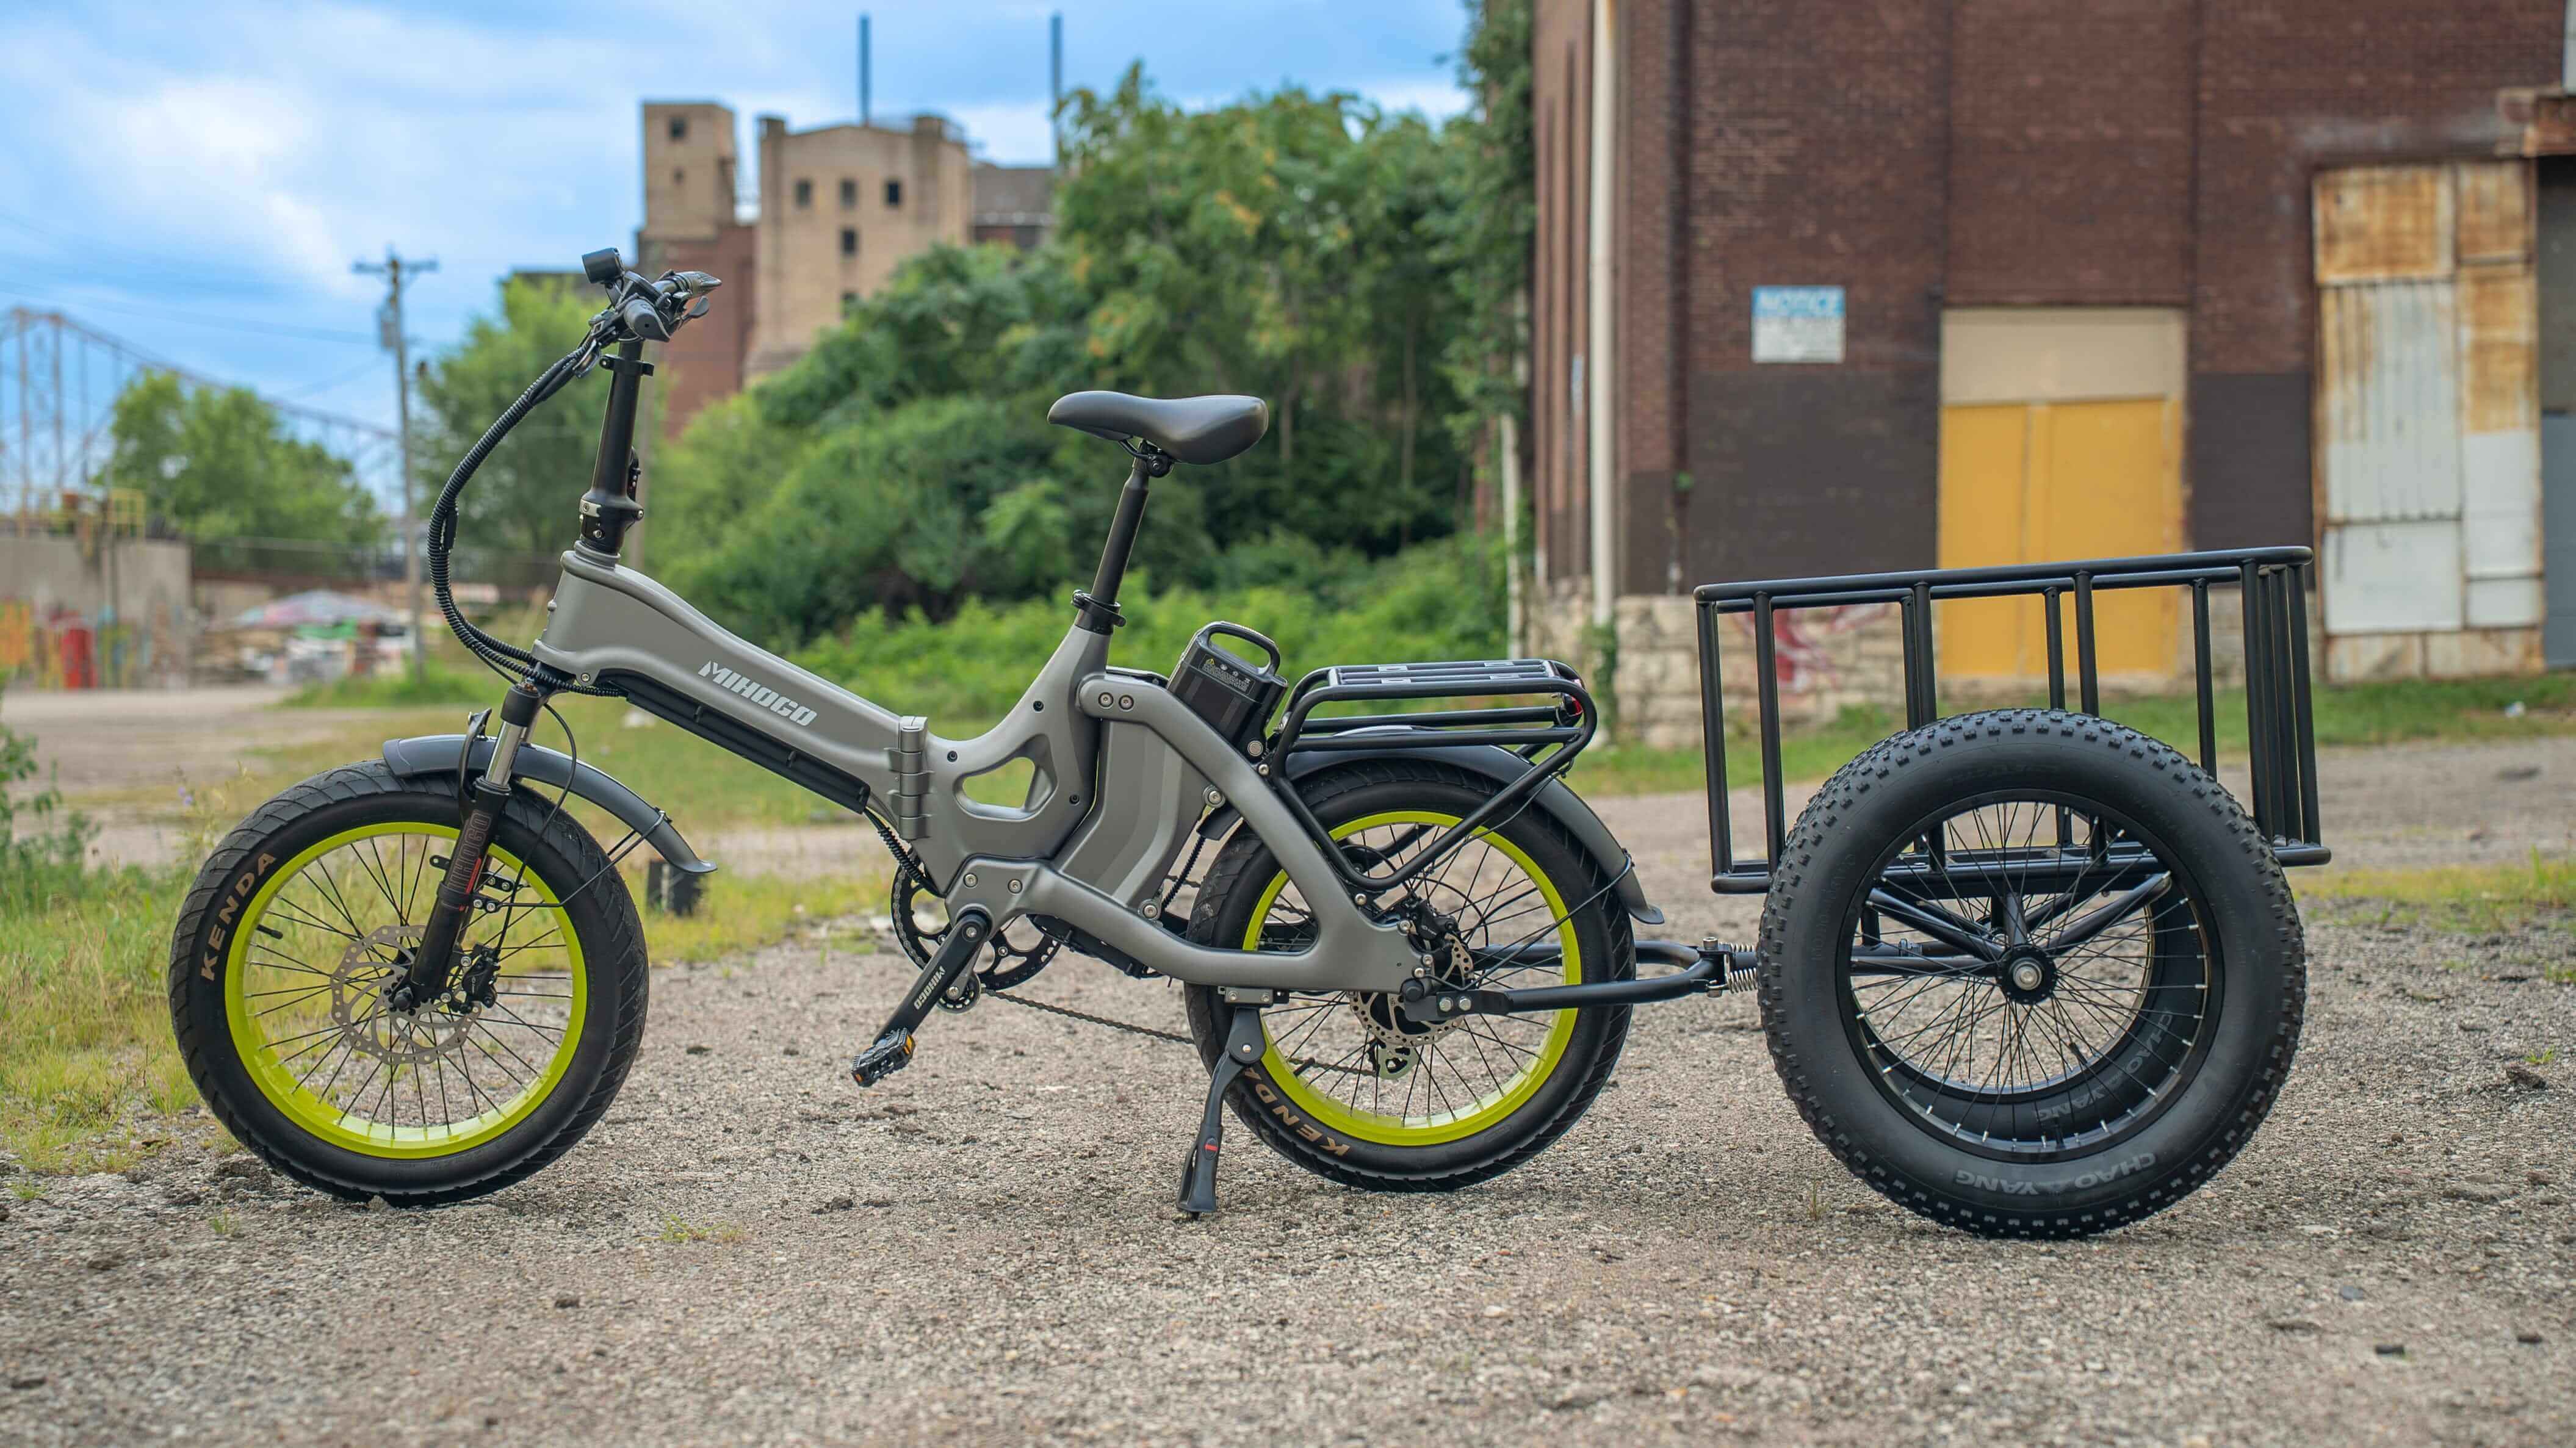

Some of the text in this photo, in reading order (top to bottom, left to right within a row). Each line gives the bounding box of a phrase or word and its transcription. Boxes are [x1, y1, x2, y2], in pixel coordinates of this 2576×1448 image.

[1757, 292, 1839, 315] NOTICE
[698, 660, 817, 726] MIHOGO
[200, 853, 276, 981] KENDA
[914, 966, 945, 1009] MIHOGO
[1955, 1153, 2156, 1195] CHAO YANG
